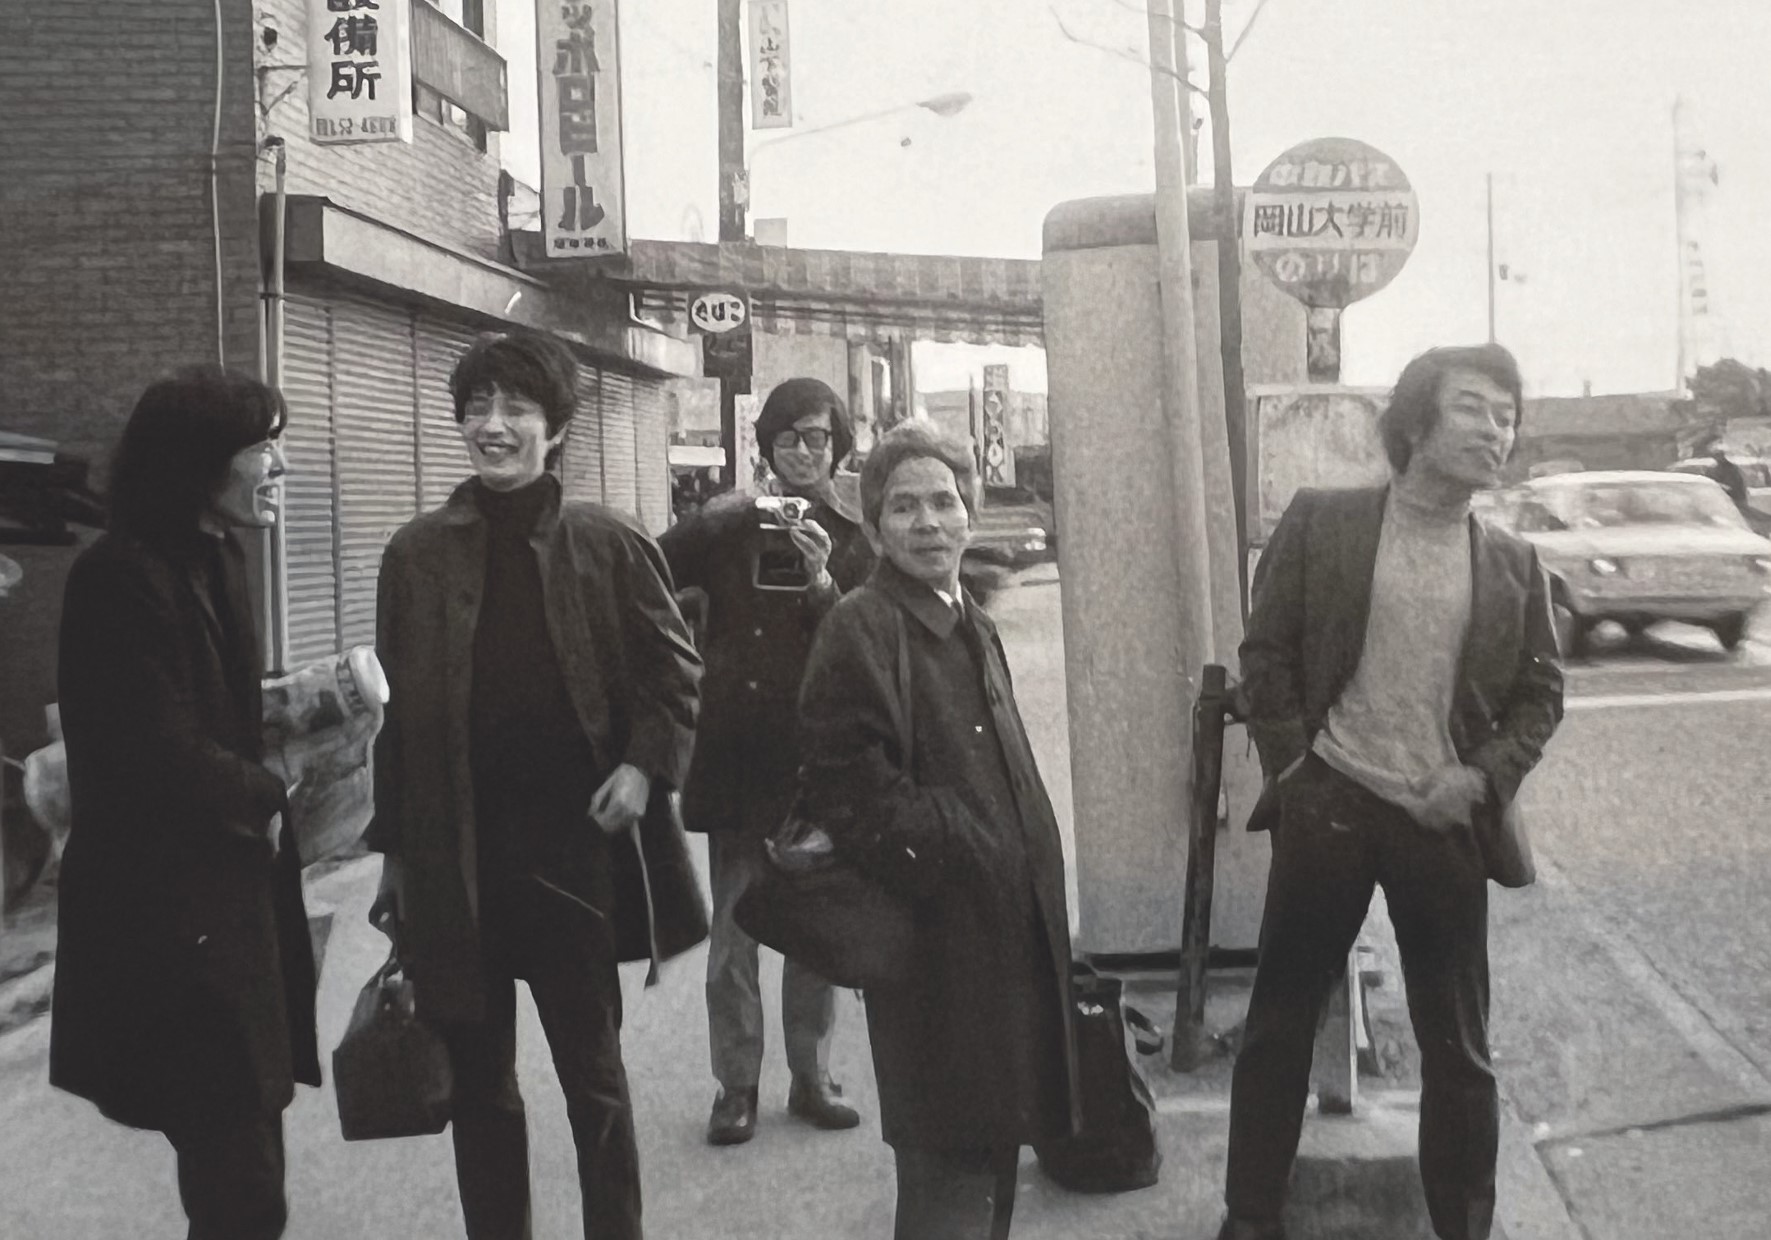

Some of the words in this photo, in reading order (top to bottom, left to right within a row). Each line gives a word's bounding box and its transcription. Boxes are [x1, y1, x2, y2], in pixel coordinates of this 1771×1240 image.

[1254, 200, 1408, 238] 岡山大学前
